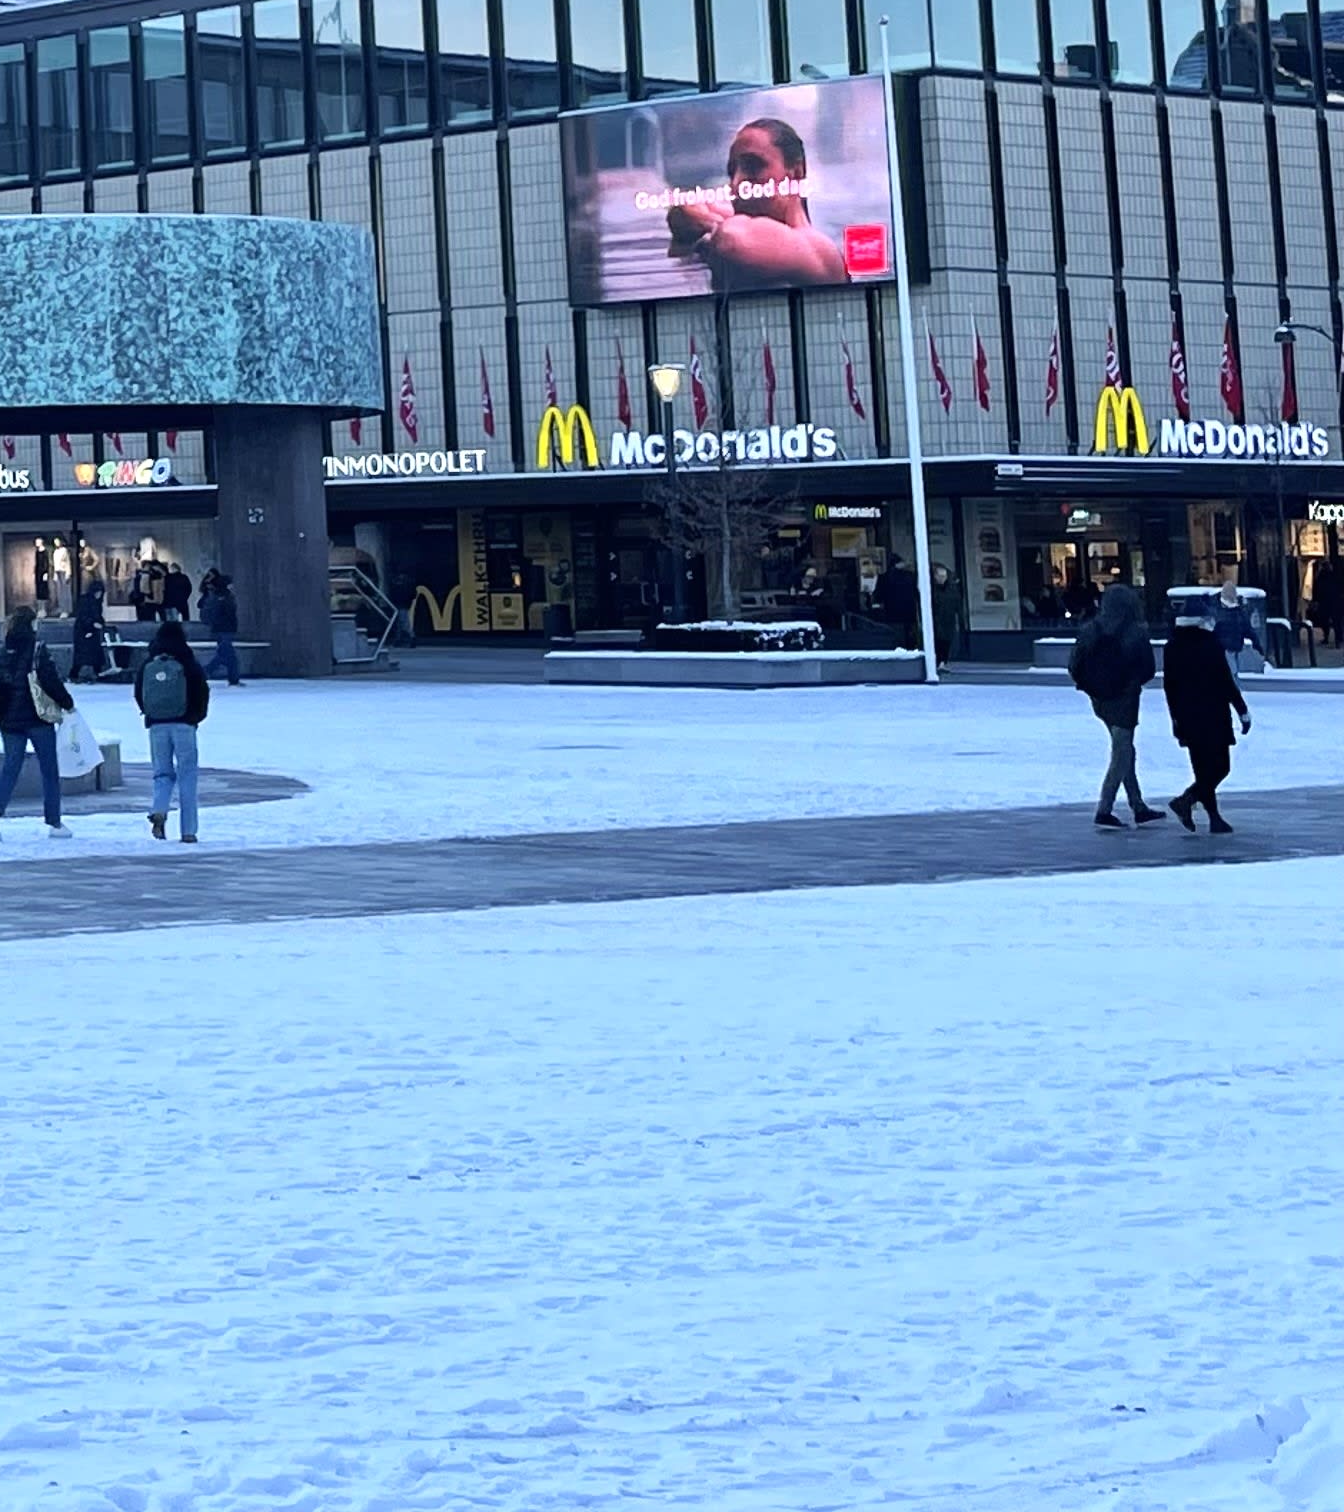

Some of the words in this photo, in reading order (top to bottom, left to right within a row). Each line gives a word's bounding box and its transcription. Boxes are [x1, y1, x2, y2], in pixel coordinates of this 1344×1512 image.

[635, 190, 669, 210] God
[739, 178, 775, 200] God
[611, 423, 836, 465] McDonald's
[1161, 418, 1329, 457] McDonald's
[828, 506, 882, 519] McDonald's
